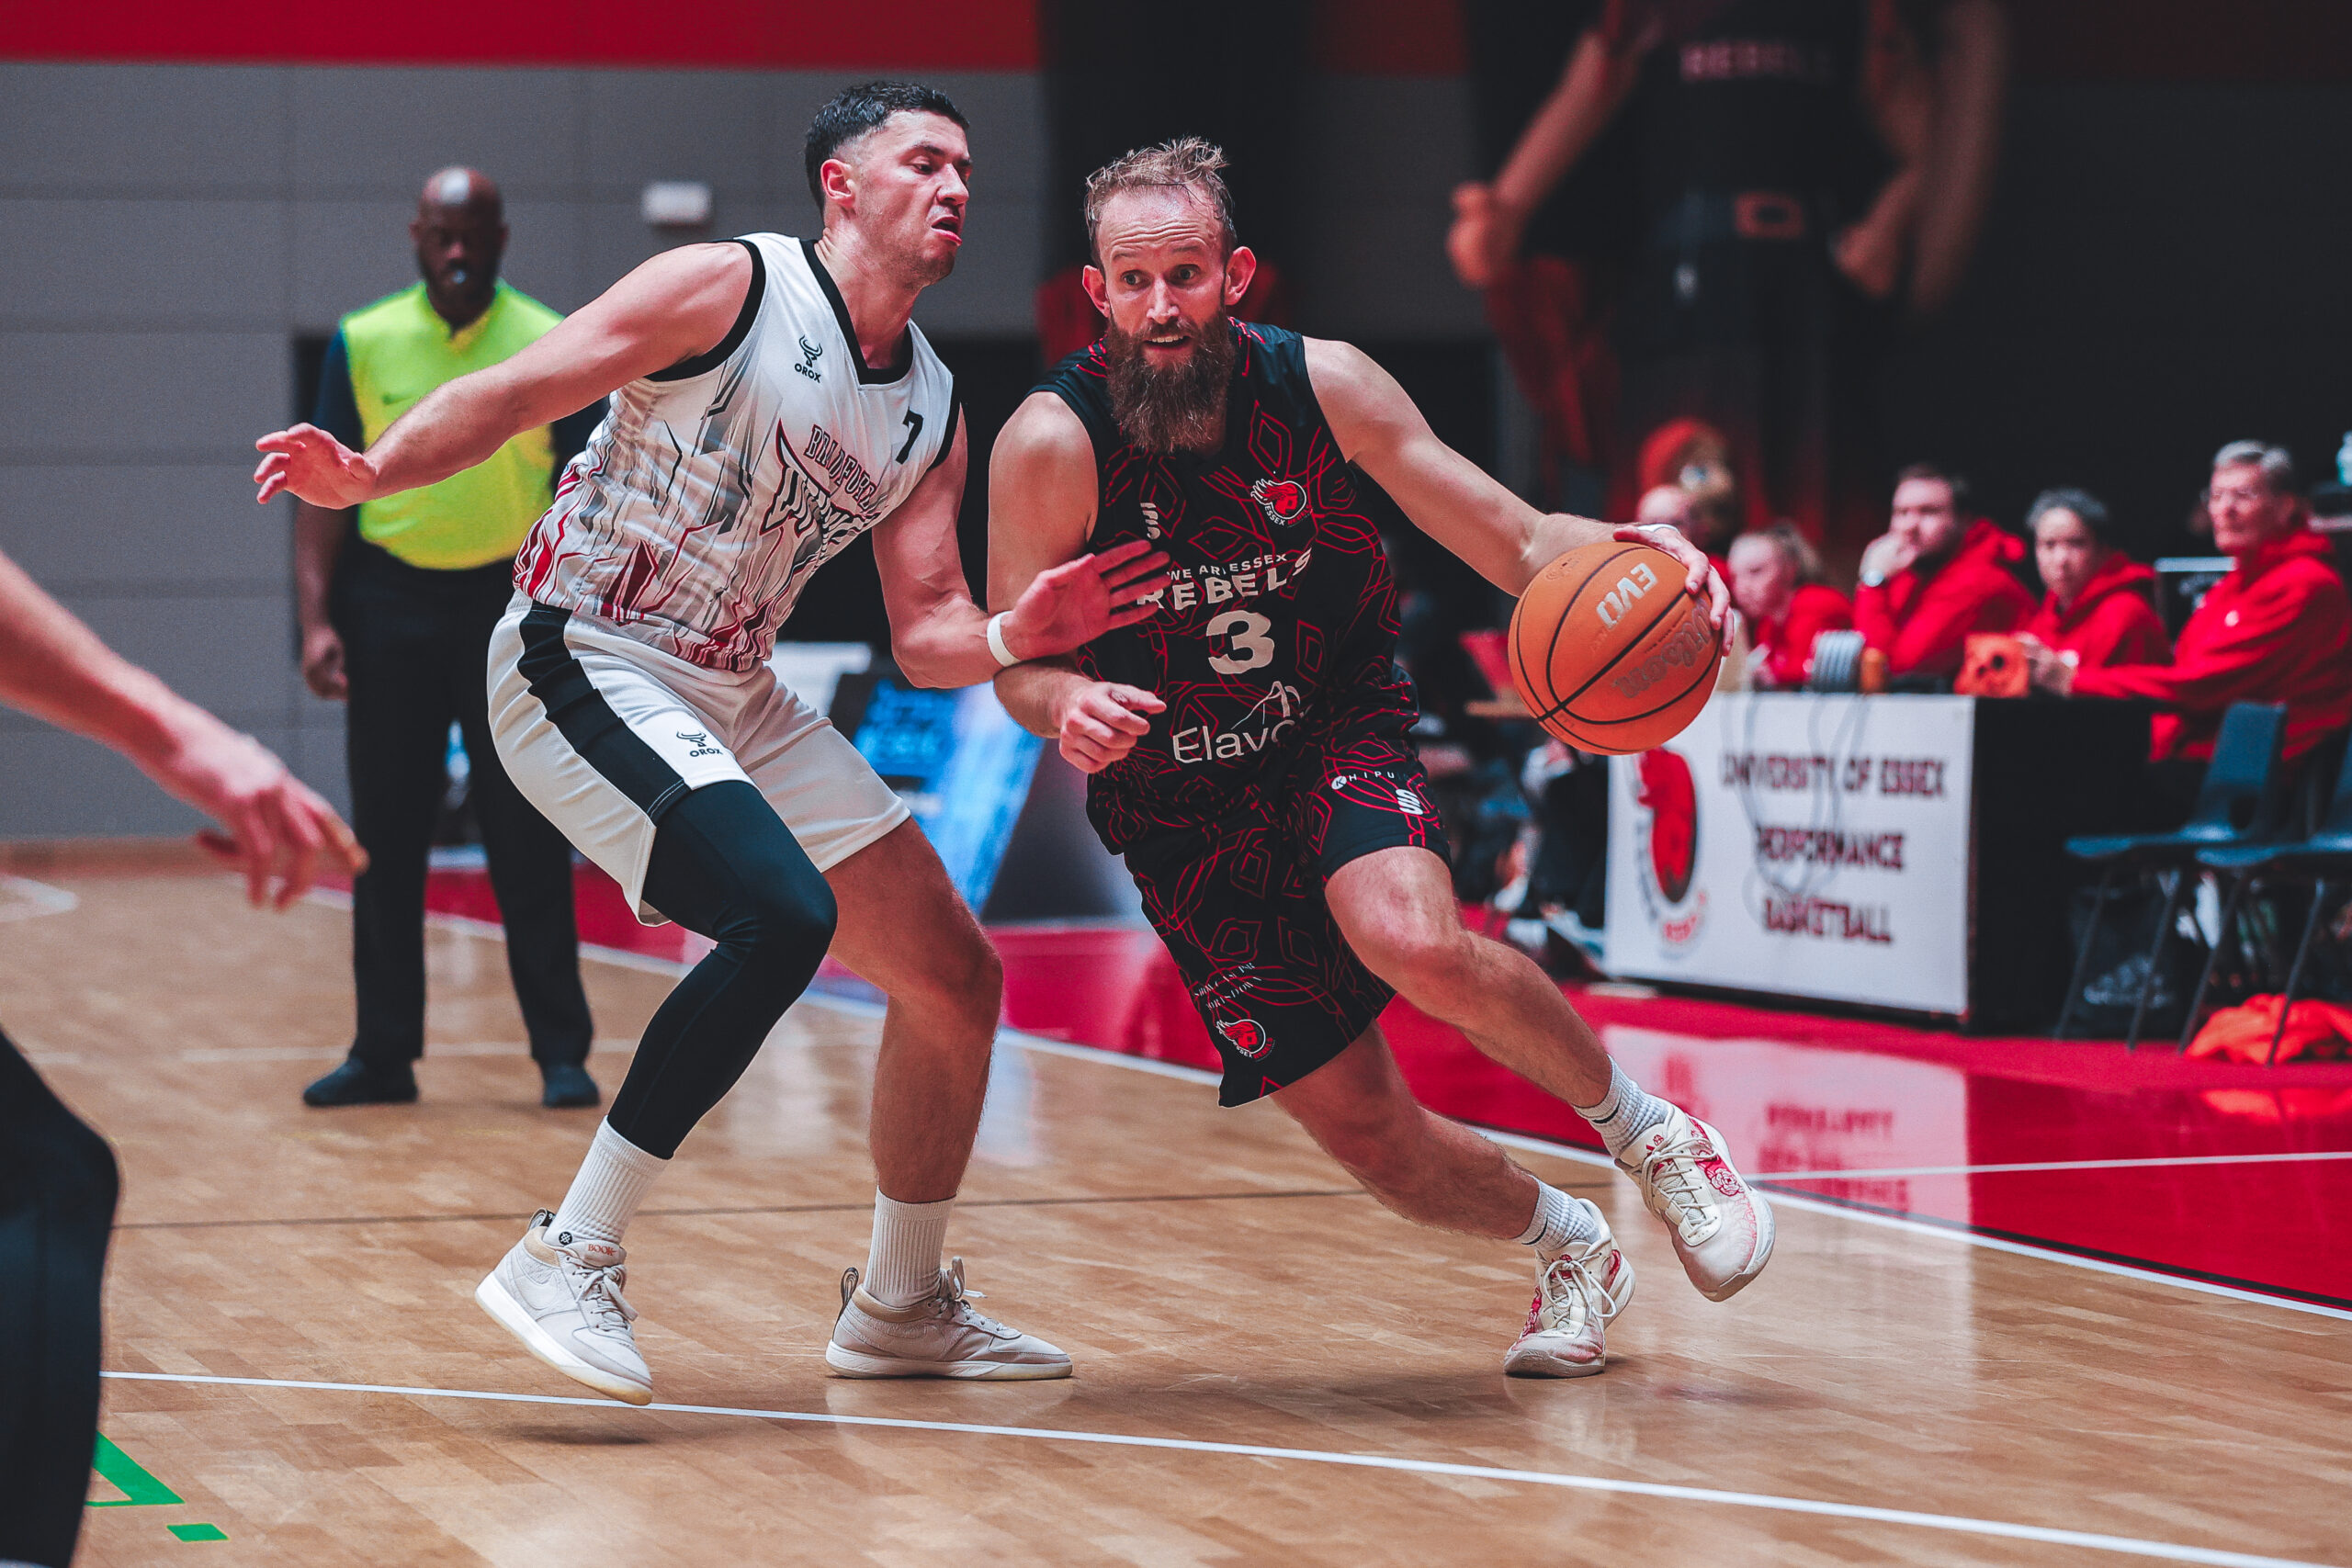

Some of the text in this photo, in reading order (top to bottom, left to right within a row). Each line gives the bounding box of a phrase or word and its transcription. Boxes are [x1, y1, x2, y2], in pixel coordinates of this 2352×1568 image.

[794, 362, 821, 384] OROX
[895, 408, 924, 465] 7
[1264, 505, 1285, 526] ESSEX
[1167, 554, 1287, 581] WE AR ESSEX
[1597, 562, 1657, 630] EVO
[1205, 609, 1275, 675] 3
[689, 748, 723, 758] OROX
[1331, 771, 1395, 790] KHIPU
[1723, 754, 1945, 796] UNIVERSITY OF ESSEX
[588, 1243, 617, 1257] BOOK
